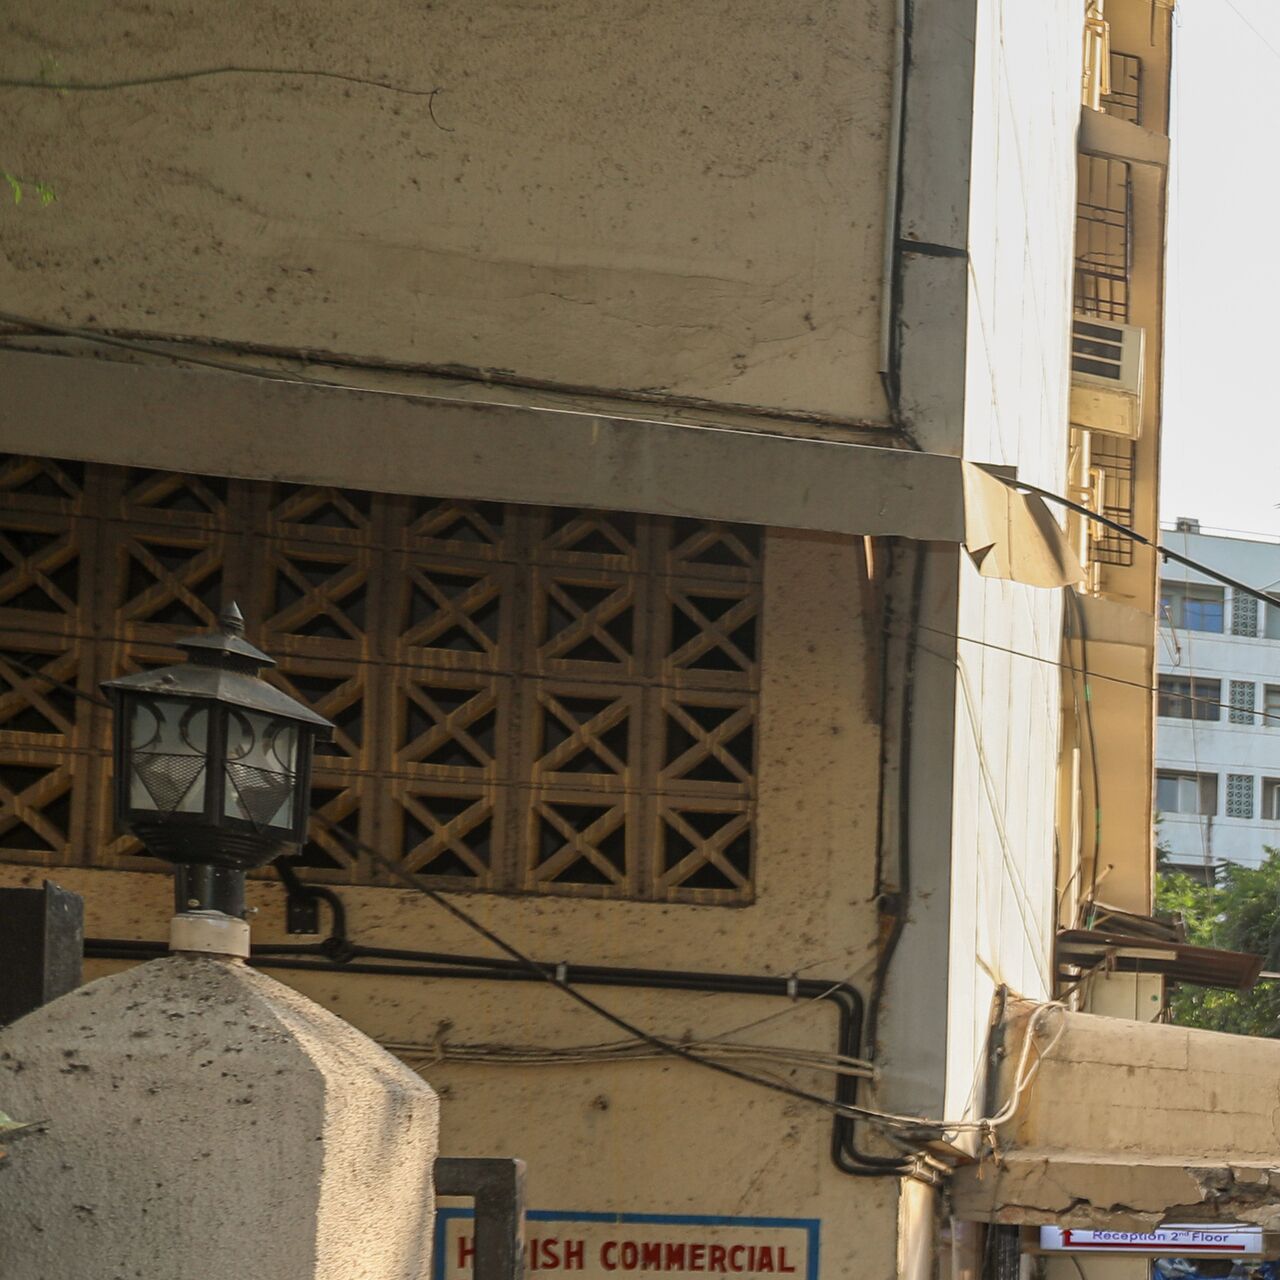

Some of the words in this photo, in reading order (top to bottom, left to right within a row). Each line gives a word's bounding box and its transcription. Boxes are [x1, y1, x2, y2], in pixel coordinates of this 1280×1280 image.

[1092, 1230, 1165, 1243] Reception
[1192, 1231, 1230, 1243] Floor
[457, 1236, 585, 1270] HISH
[600, 1241, 797, 1274] COMMERCIAL
